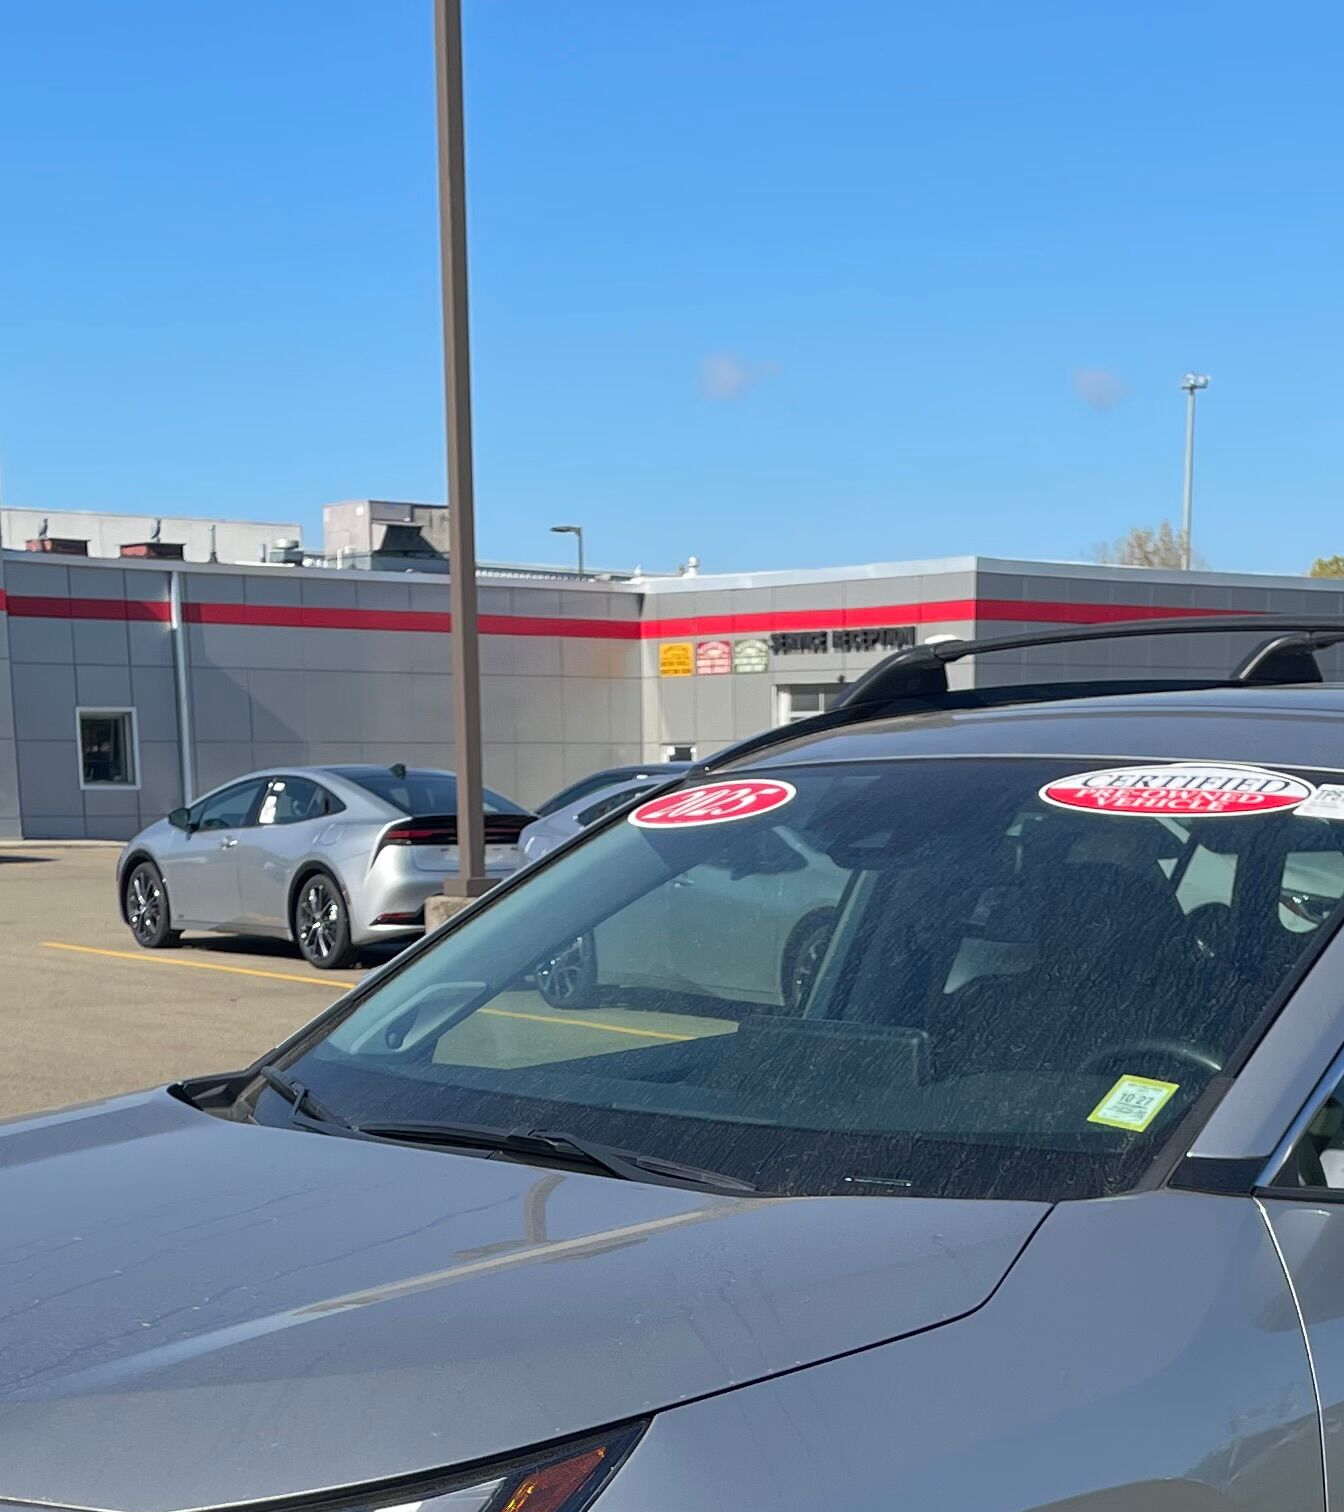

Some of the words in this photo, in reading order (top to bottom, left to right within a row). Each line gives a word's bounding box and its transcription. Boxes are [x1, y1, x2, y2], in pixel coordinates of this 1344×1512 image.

[1081, 774, 1290, 793] CERTIFIED
[640, 787, 783, 818] 2025
[1073, 788, 1266, 804] PRE-OWNED
[1096, 798, 1231, 812] VEHICLE
